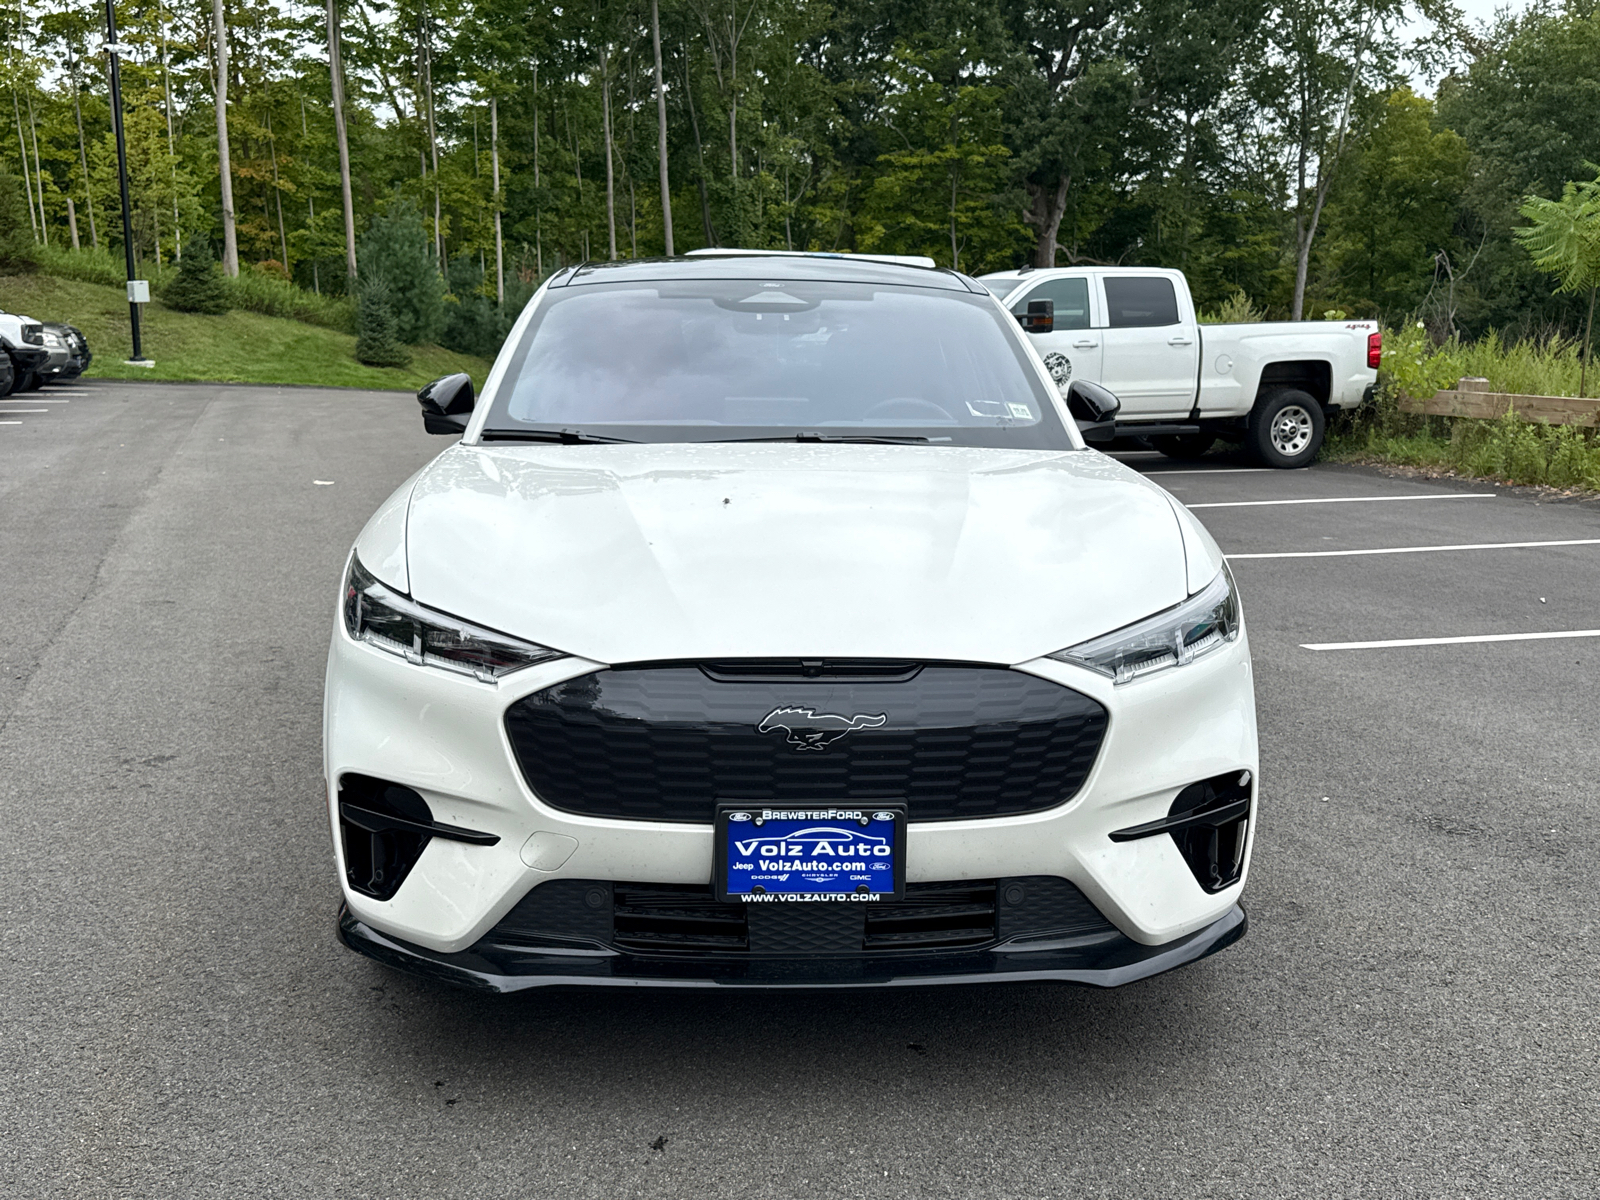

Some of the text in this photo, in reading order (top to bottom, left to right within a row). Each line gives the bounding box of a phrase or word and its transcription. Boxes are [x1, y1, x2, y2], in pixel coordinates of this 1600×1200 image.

[734, 841, 891, 857] Volz Auto
[733, 861, 754, 871] Jeep
[759, 859, 866, 871] VolzAuto.com
[741, 893, 880, 902] WWW.VOLZAUTO.COM
